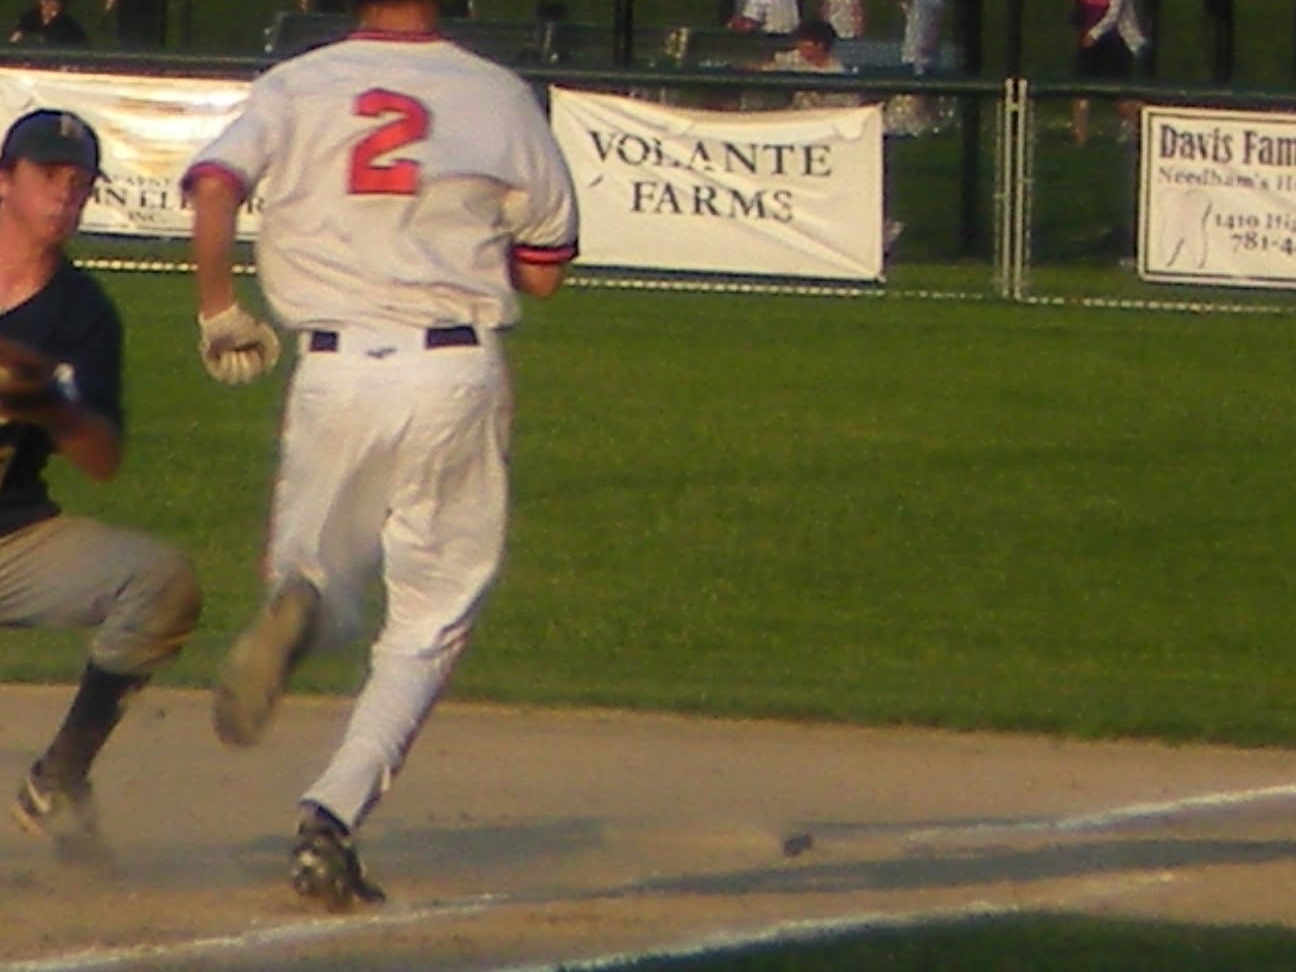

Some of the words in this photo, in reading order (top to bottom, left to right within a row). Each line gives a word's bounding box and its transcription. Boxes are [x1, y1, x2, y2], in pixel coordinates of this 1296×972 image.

[348, 87, 433, 195] 2
[588, 131, 832, 177] VOLANTE
[1159, 124, 1233, 164] Davis
[631, 181, 793, 222] FARMS
